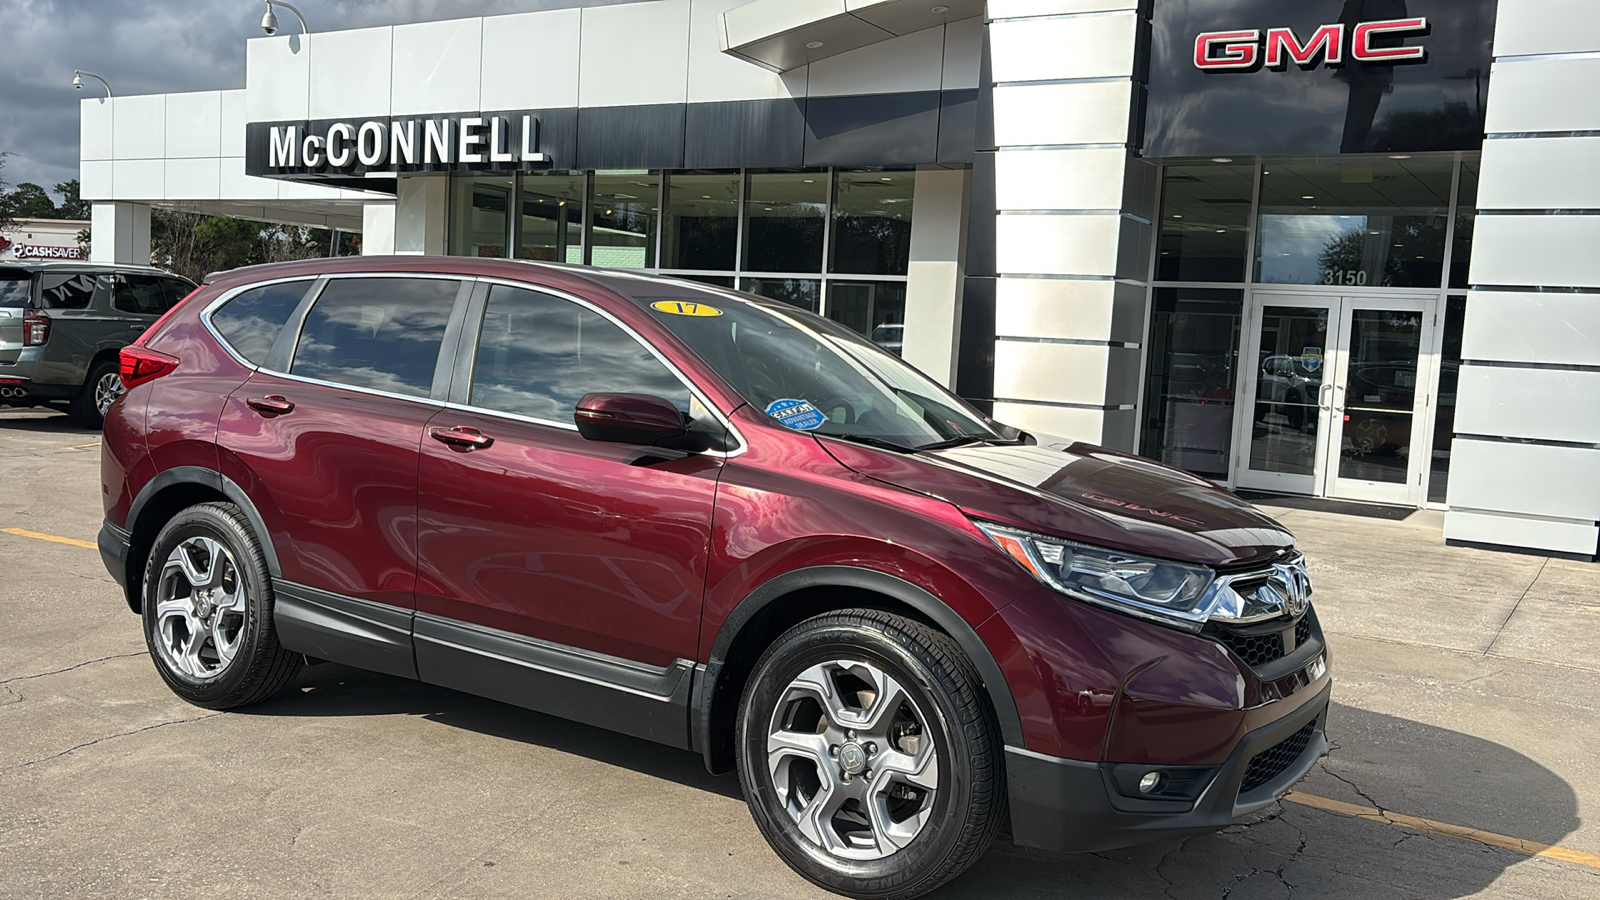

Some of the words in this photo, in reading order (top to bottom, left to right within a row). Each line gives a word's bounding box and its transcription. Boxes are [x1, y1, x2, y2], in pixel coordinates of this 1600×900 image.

[1193, 17, 1427, 69] GMC
[268, 115, 545, 168] McCONNELL
[1323, 269, 1367, 286] 3150
[676, 302, 698, 314] 17
